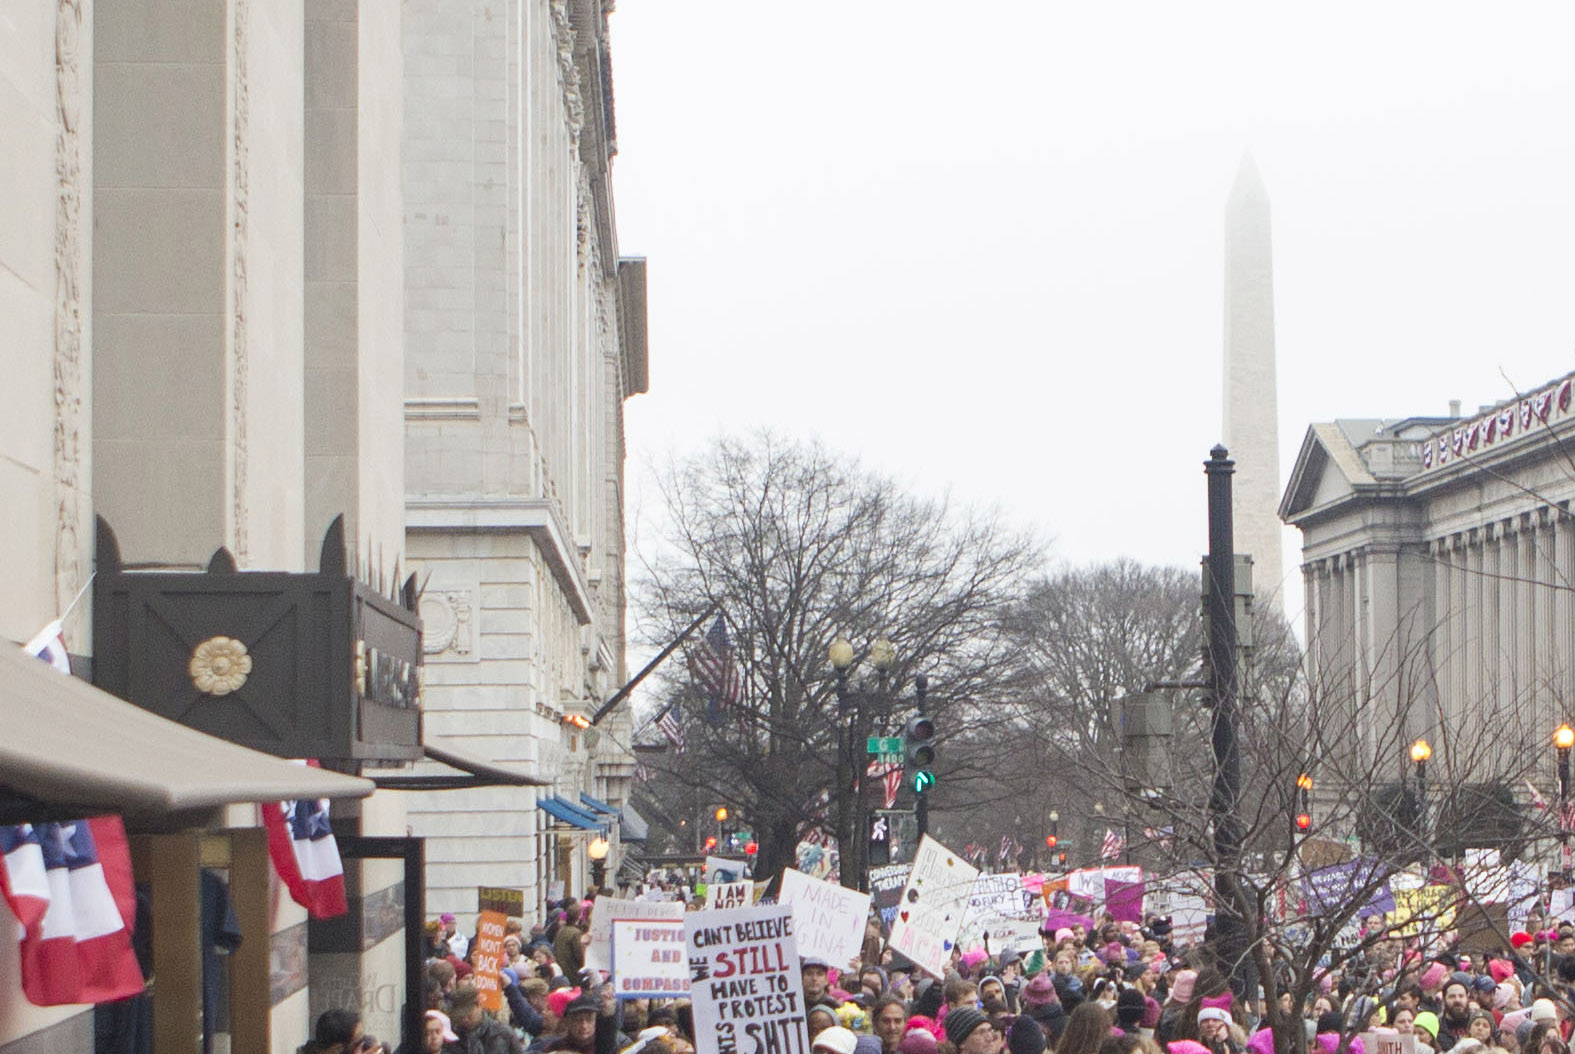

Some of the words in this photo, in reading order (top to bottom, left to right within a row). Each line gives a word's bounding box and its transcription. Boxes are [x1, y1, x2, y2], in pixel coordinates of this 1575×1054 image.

[880, 754, 905, 764] 1400
[726, 885, 746, 899] AM
[804, 884, 849, 914] MADE
[811, 908, 833, 929] IN
[634, 928, 686, 942] JUSTIC
[693, 925, 732, 948] CAN'T
[736, 915, 794, 942] BELIEVE
[794, 918, 846, 956] GINA
[479, 954, 499, 974] BACK
[651, 949, 681, 963] AND
[713, 943, 790, 978] STILL
[689, 956, 711, 983] WE
[477, 975, 498, 991] DOWN
[622, 977, 691, 991] COMPASS
[711, 977, 758, 1000] HAVE
[765, 975, 789, 993] TO
[719, 992, 797, 1019] PROTEST
